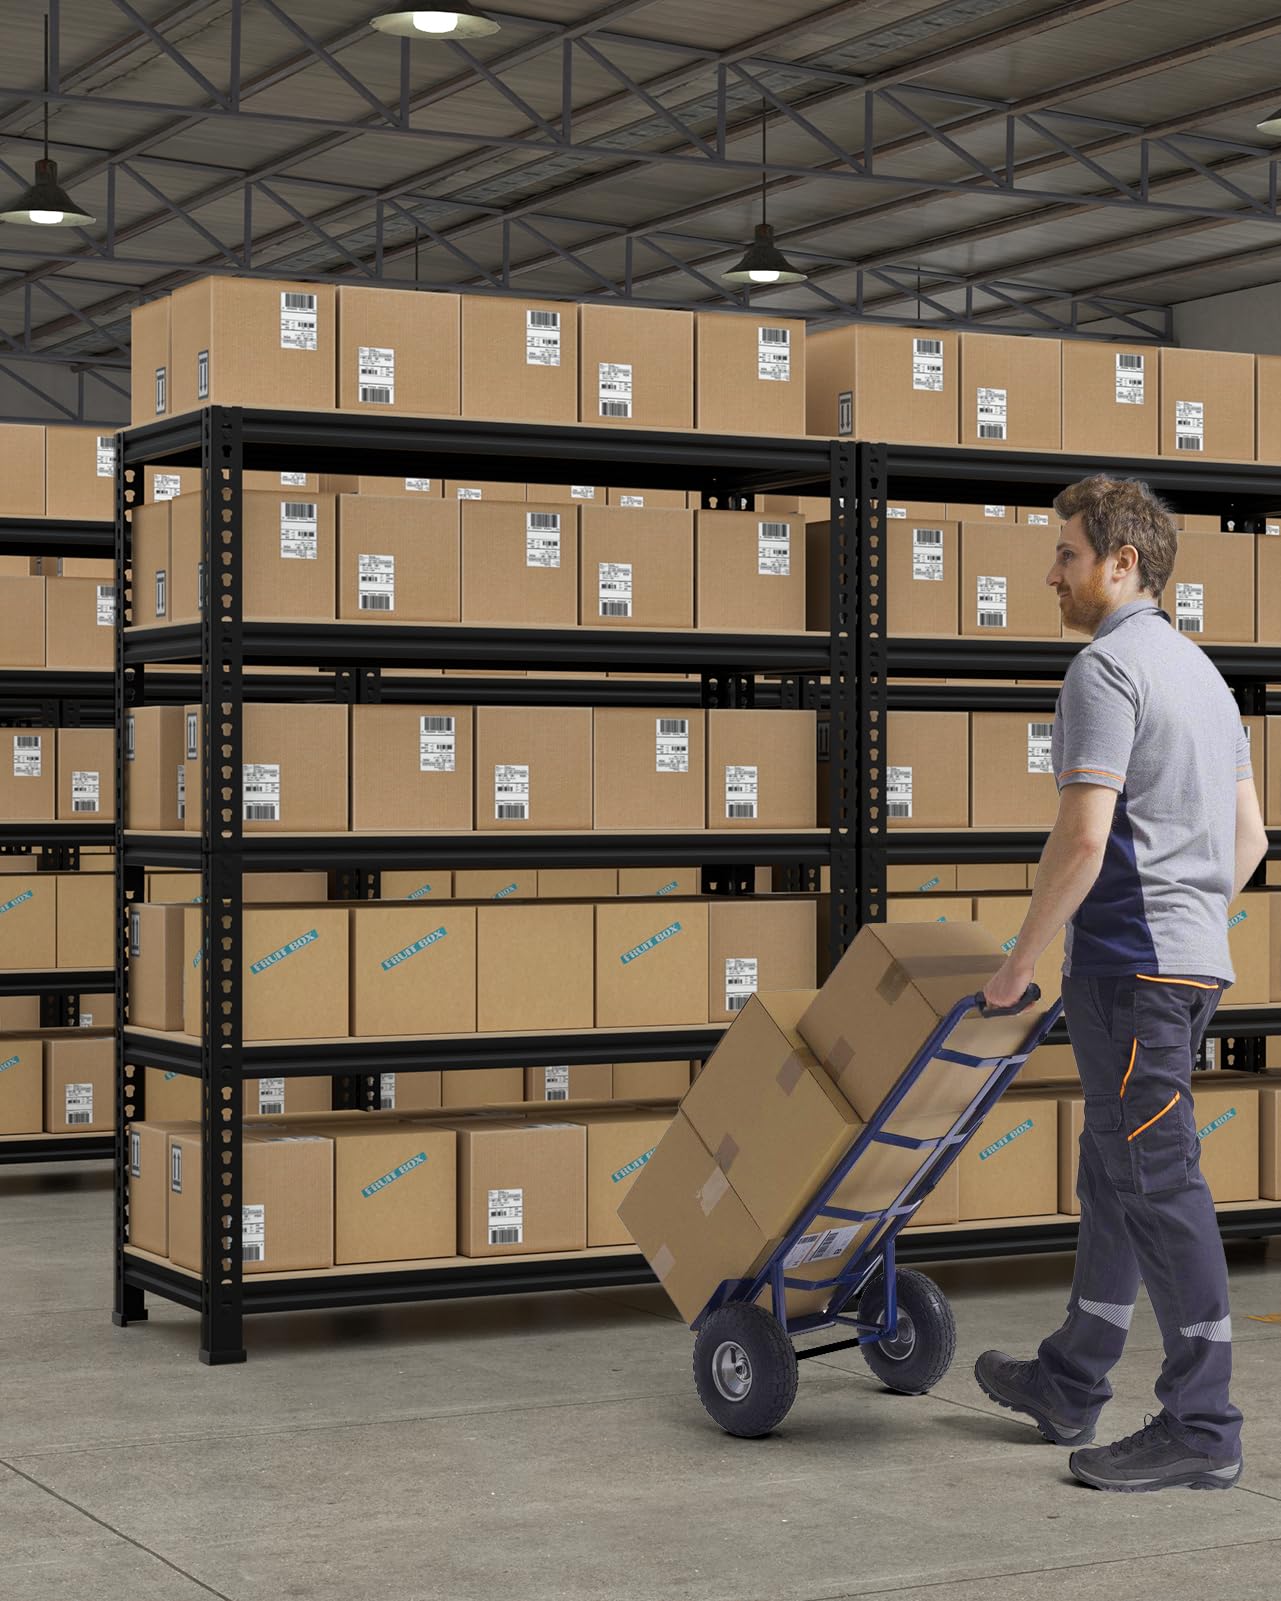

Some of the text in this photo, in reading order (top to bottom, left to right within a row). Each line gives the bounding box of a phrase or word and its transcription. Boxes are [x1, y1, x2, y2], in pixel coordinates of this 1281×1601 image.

[252, 932, 315, 972] FRUIT BOX
[384, 929, 443, 968] FRUIT BOX
[622, 924, 678, 962] FRUIT BOX
[1214, 1112, 1233, 1126] BOX
[982, 1120, 1030, 1157] FRUIT BOX
[364, 1154, 423, 1195] FRUIT BOX
[614, 1156, 645, 1180] FRUIT
